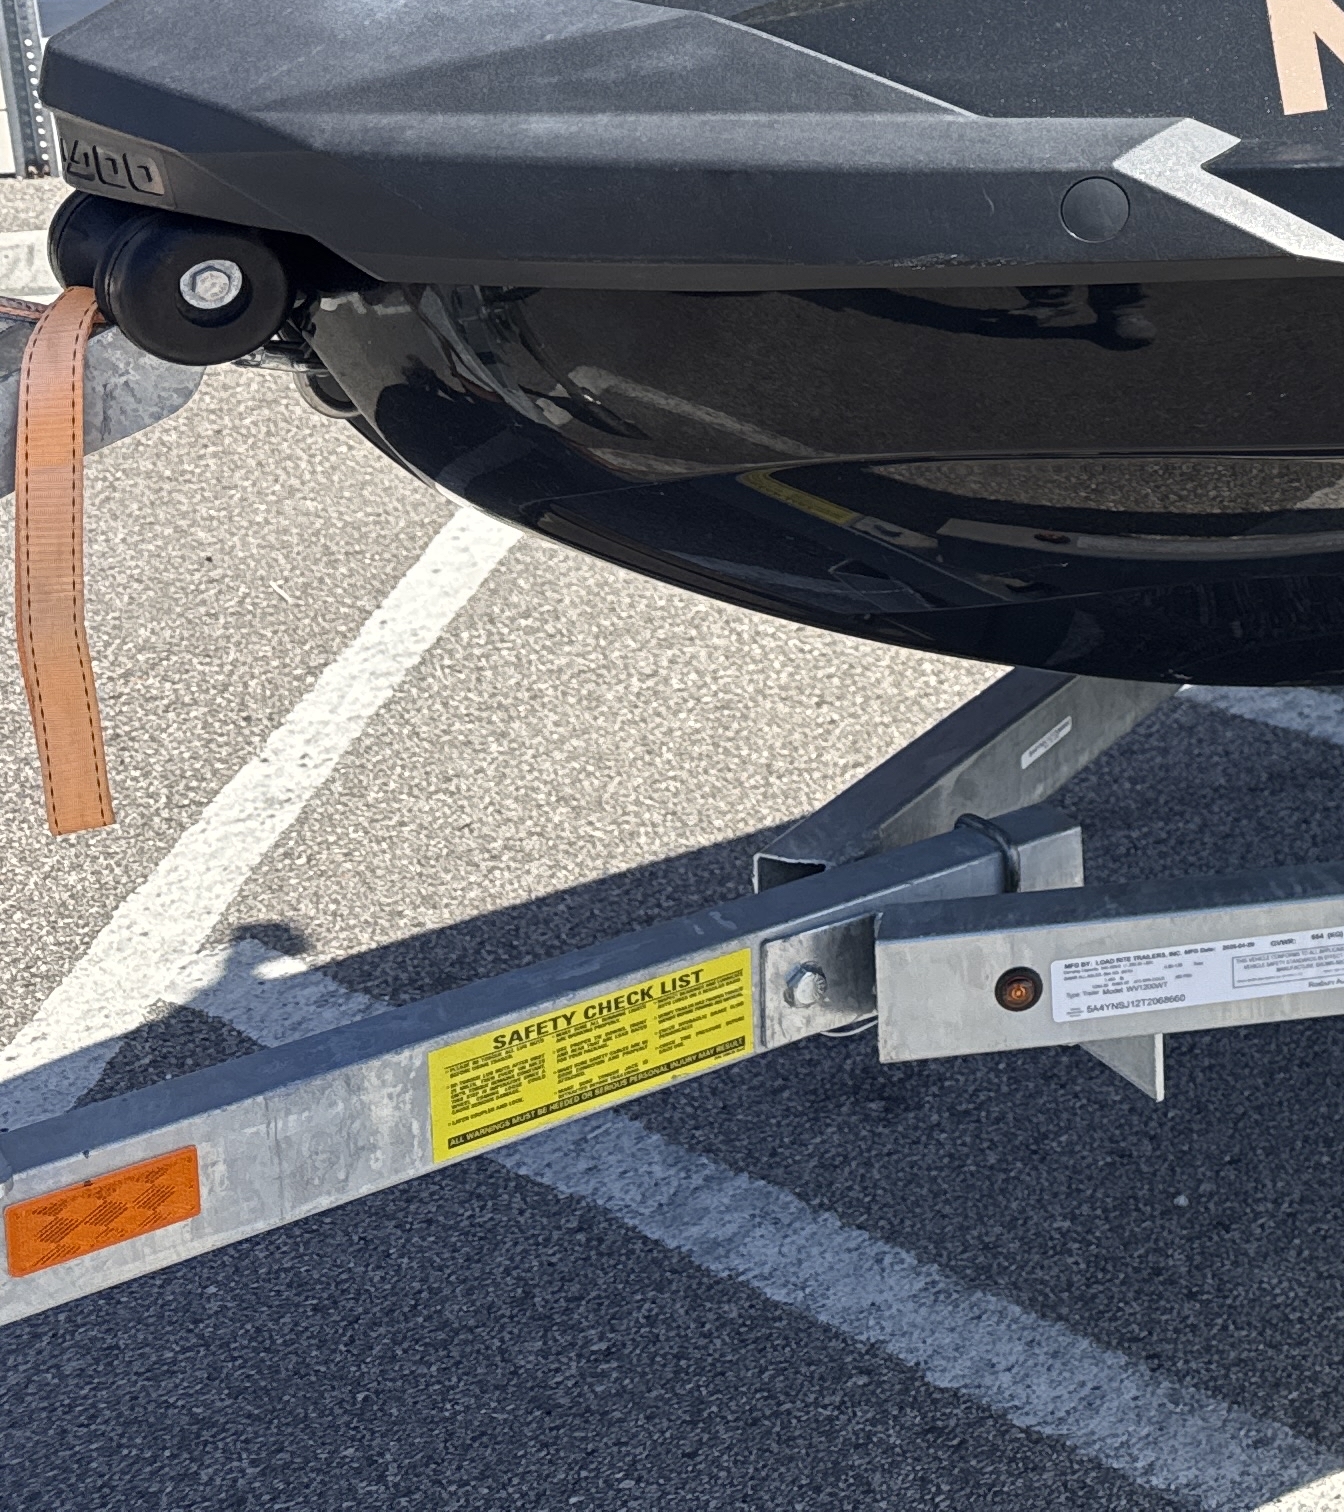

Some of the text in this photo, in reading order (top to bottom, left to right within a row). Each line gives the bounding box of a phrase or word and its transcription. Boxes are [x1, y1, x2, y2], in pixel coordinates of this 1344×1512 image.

[493, 1011, 578, 1050] SAFETY
[583, 986, 654, 1020] CHECK
[660, 969, 705, 995] LIST
[450, 1138, 464, 1147] ALL
[466, 1123, 511, 1141] WARNINGS
[512, 1112, 535, 1124] MUST
[594, 1079, 628, 1096] SERIOUS
[629, 1063, 669, 1083] PERSONAL
